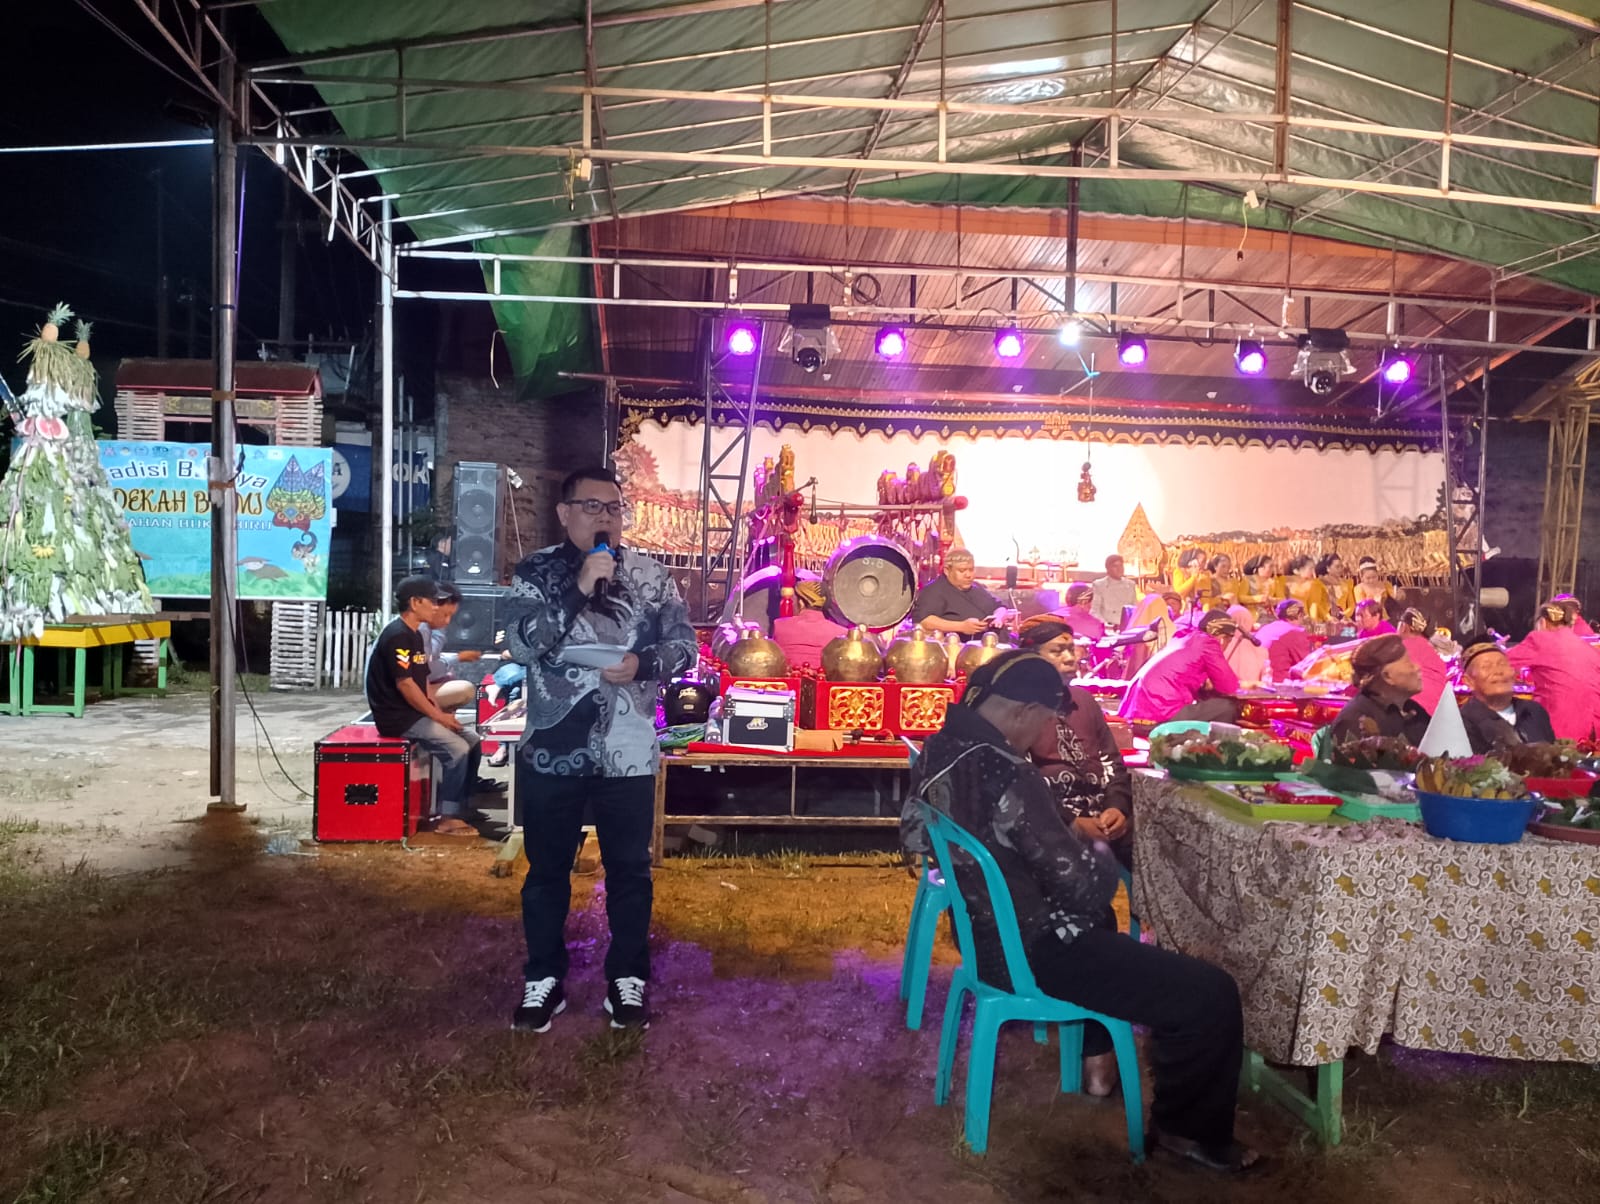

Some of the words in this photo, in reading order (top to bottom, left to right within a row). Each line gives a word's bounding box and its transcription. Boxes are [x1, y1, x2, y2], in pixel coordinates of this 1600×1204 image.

[109, 461, 167, 479] adisi
[113, 487, 187, 513] DEKAH
[193, 490, 264, 516] BMI
